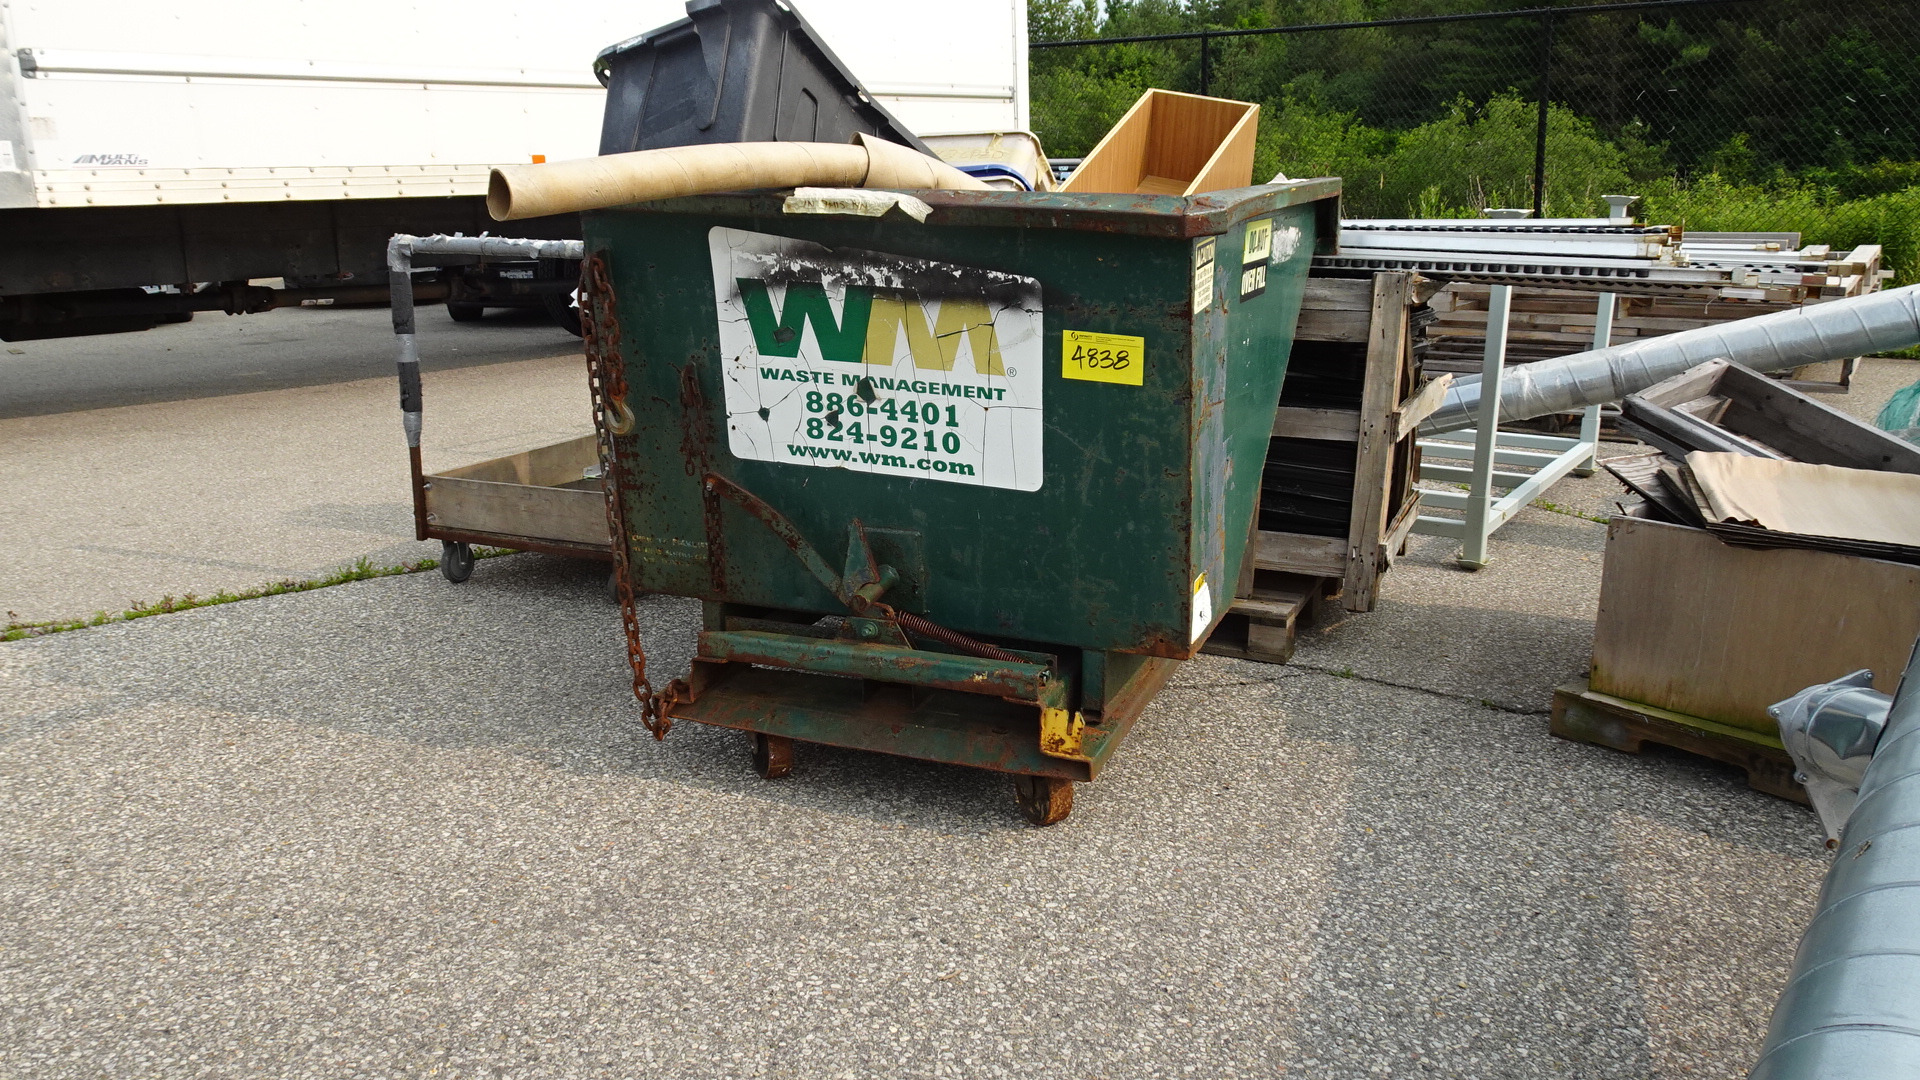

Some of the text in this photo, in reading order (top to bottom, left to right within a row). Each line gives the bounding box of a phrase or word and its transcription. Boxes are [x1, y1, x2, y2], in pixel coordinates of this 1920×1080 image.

[736, 277, 1006, 376] WM
[1071, 345, 1129, 370] 4838
[760, 367, 834, 385] WASTE
[805, 391, 959, 428] 886-4401
[806, 417, 961, 455] 824-9210
[787, 444, 975, 476] www.wm.com
